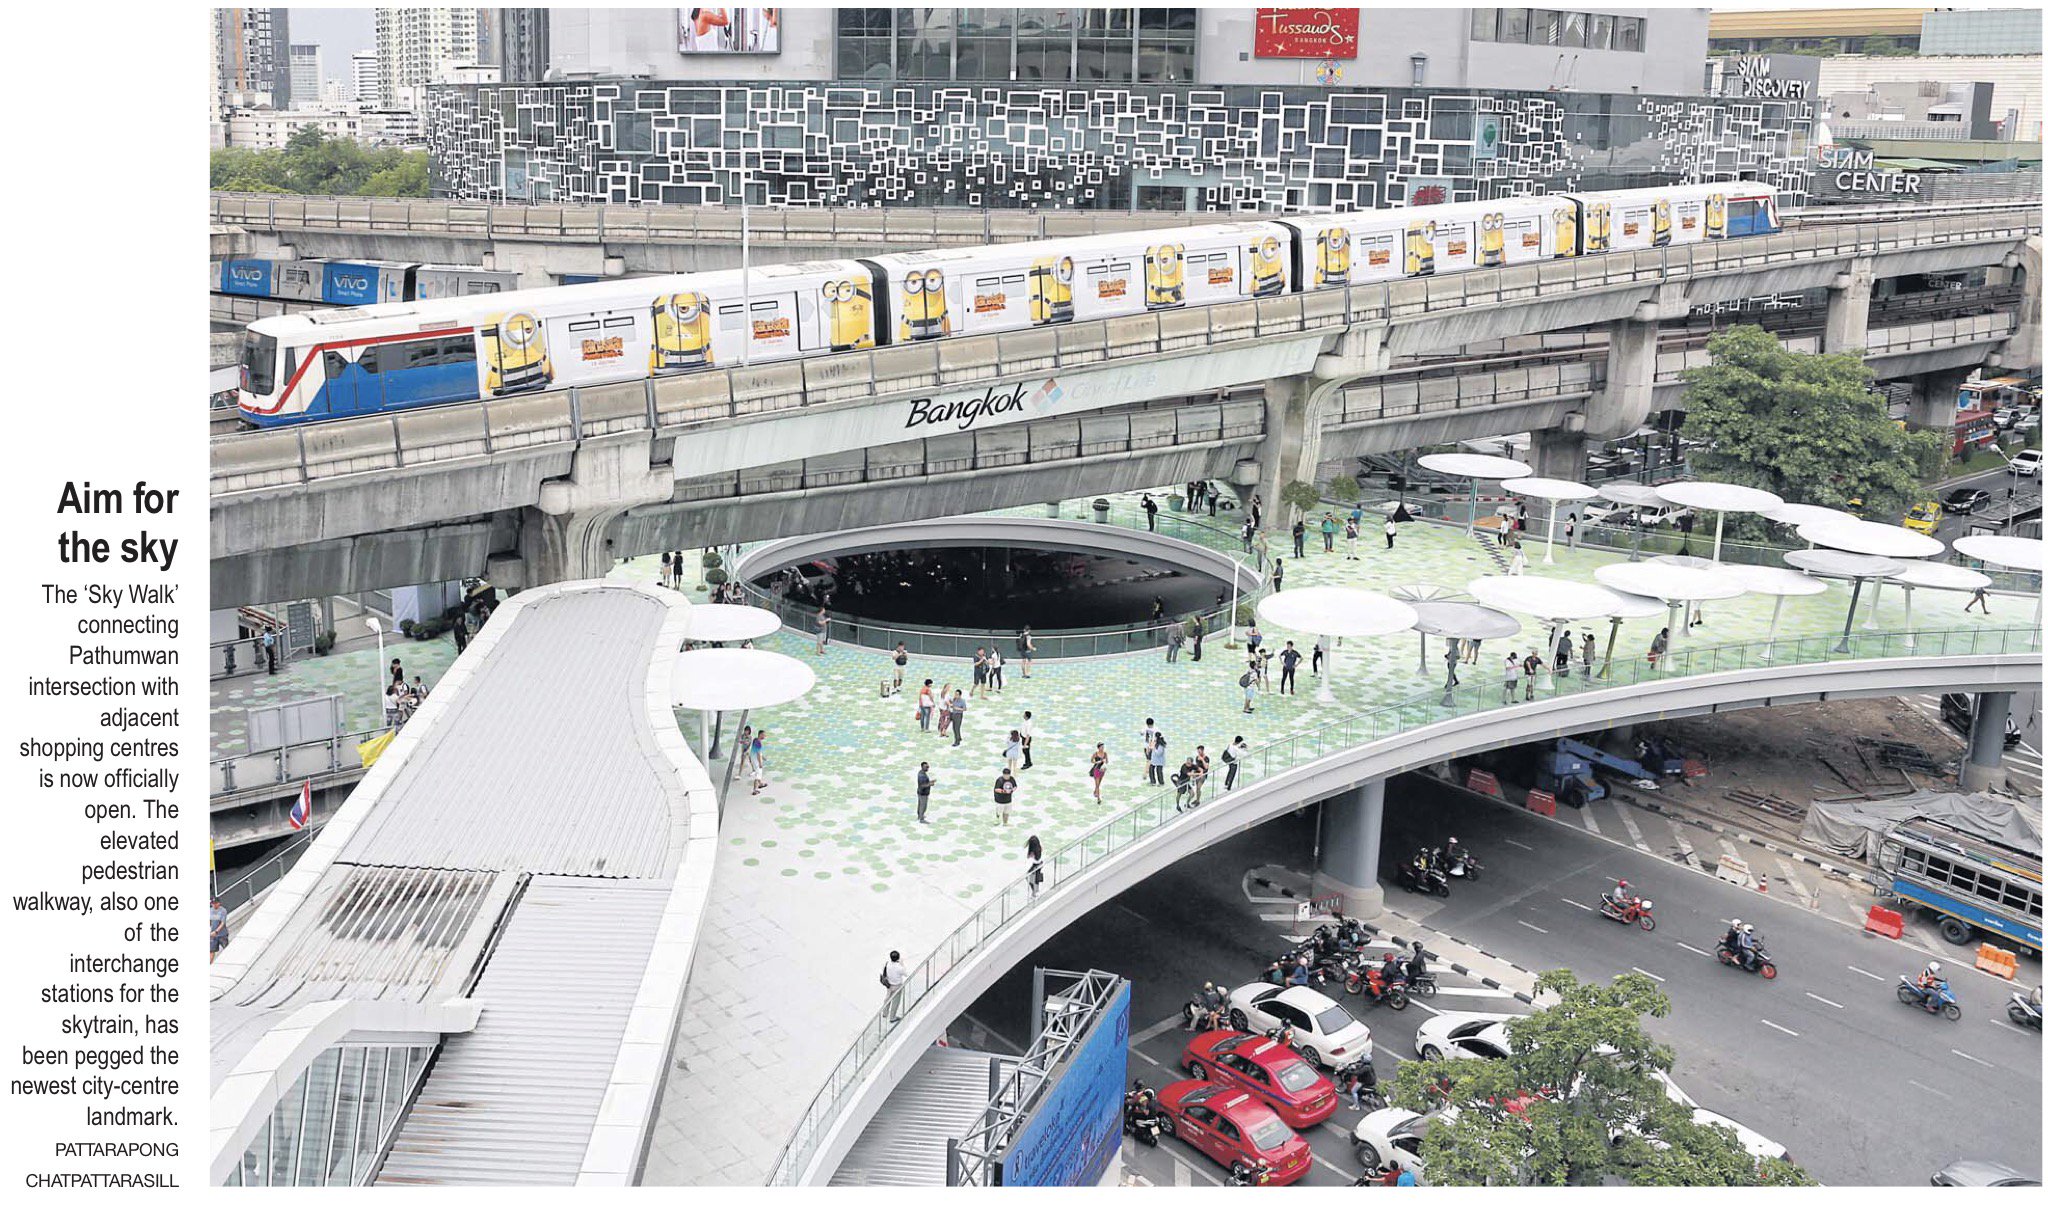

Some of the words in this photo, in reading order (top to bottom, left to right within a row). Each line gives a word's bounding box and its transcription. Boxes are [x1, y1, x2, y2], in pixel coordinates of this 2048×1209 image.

[1261, 8, 1344, 45] Tussauds
[1738, 56, 1770, 77] SIAM
[1744, 77, 1811, 98] DISCOVERY
[1820, 149, 1875, 170] SIAM
[1836, 171, 1921, 194] CENTER
[905, 382, 1028, 430] Bangkok
